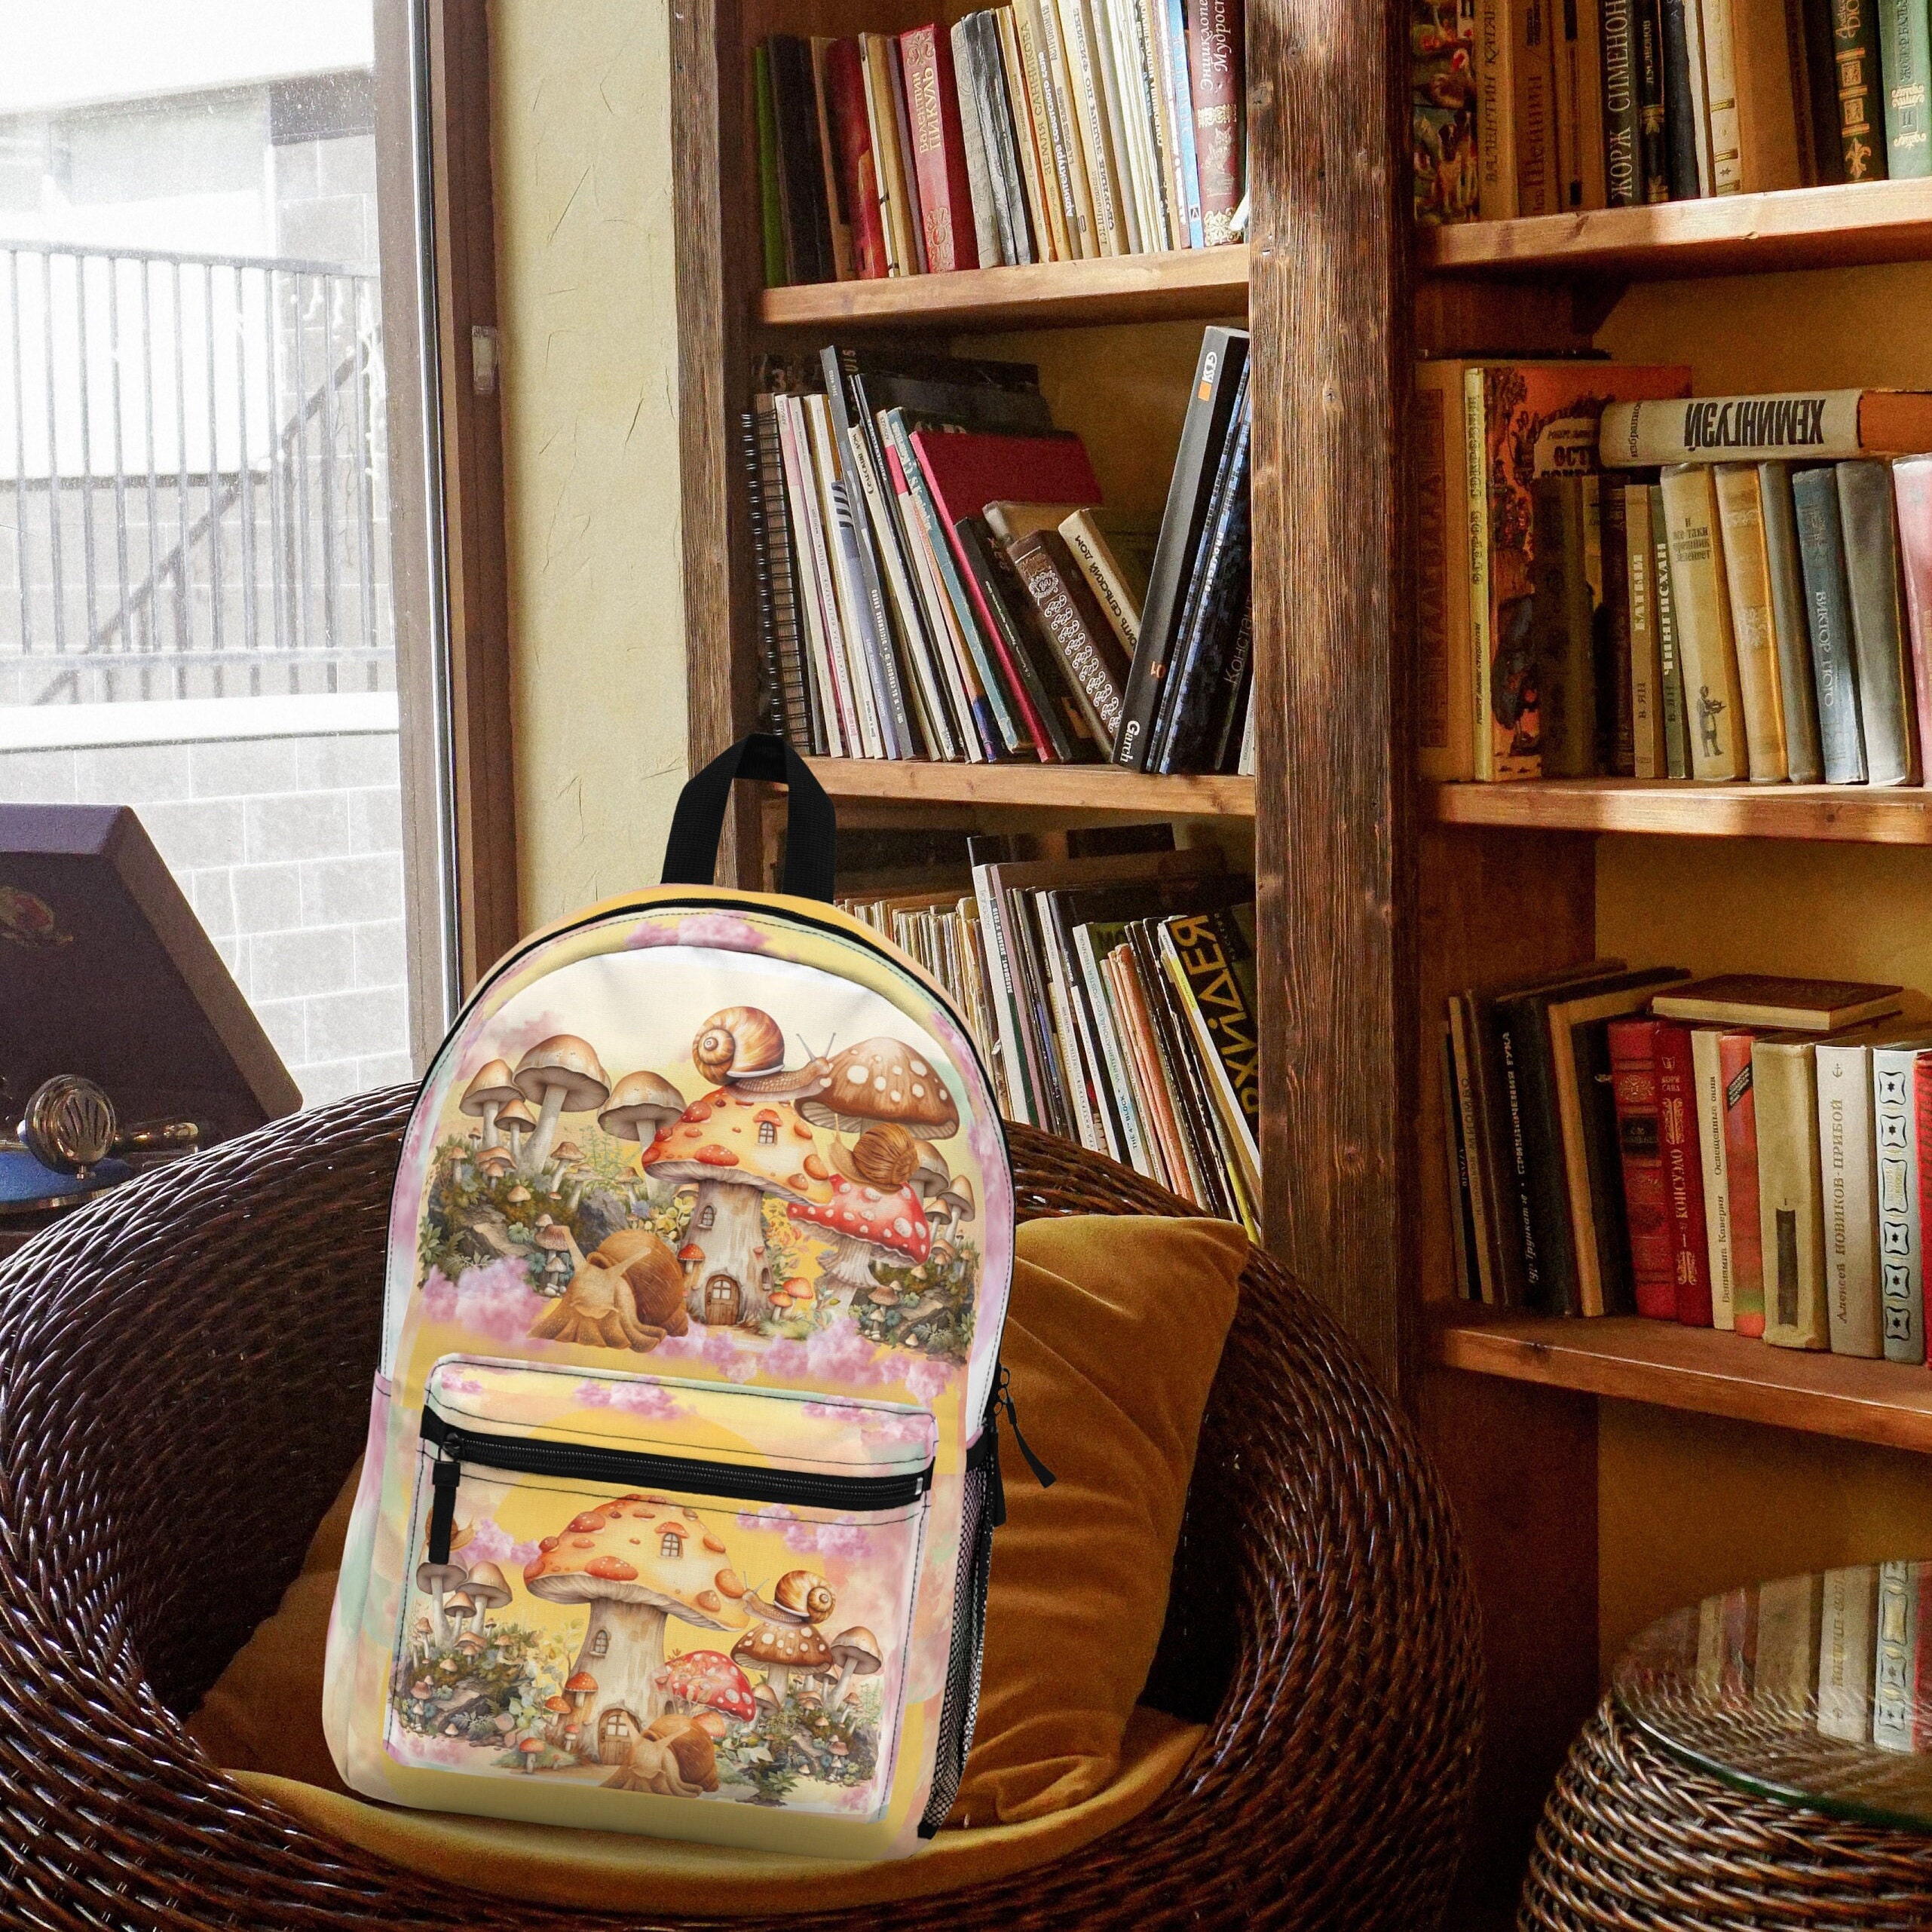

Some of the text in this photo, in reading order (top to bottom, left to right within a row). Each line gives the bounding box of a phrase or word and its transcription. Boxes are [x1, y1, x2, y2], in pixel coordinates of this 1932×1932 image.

[1018, 22, 1043, 117] САННИКОВА
[1605, 0, 1633, 198] ЖОРЖ СИМЕНОН
[919, 66, 943, 150] ПИКУЛЬ
[1042, 80, 1061, 142] советского
[1036, 121, 1052, 176] ЗЕМЛЯ
[1053, 144, 1075, 217] Архитектура
[1682, 399, 1826, 452] ХЕМИНГУЭЙ
[1075, 534, 1138, 648] ОИТЬ СЕЛЬСКИЙ ДОМ
[1655, 543, 1673, 675] ЧИНГИСХАН
[1814, 591, 1836, 706] ВИКТОР ГЮГО
[1119, 720, 1141, 764] Garch
[1119, 1095, 1131, 1122] BLOCK
[1128, 1134, 1138, 1150] THE
[1668, 1148, 1689, 1219] КОНСУЭЛО
[1835, 1263, 1847, 1324] Алексей
